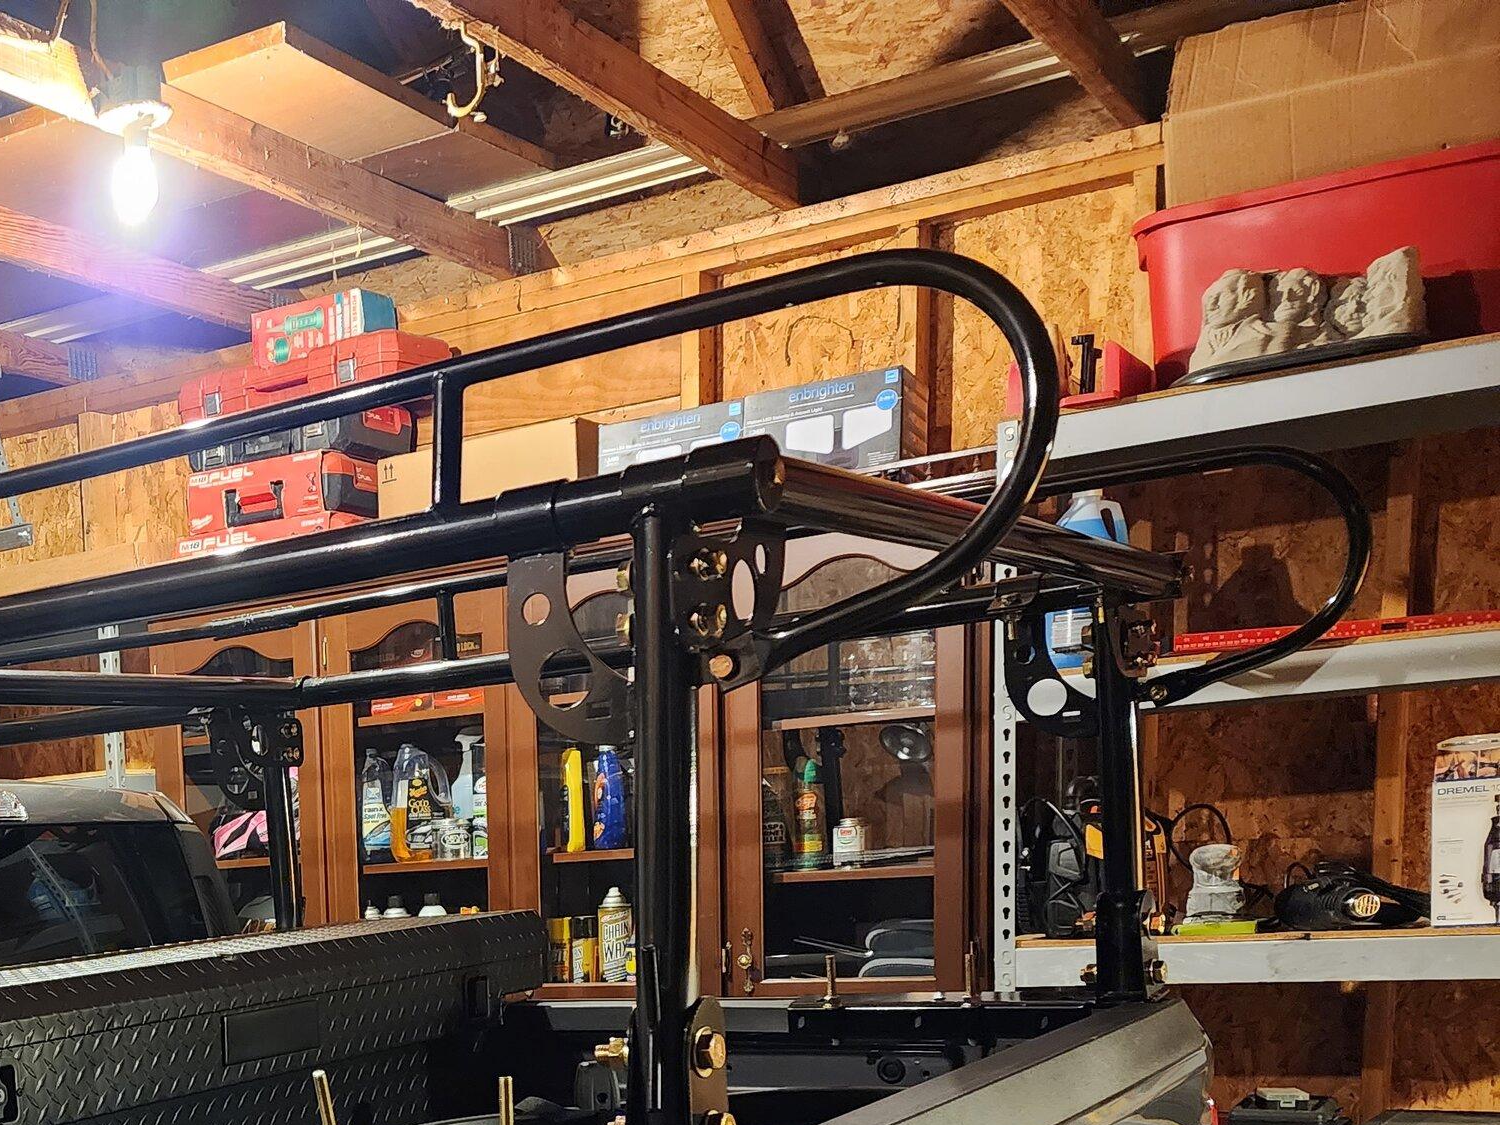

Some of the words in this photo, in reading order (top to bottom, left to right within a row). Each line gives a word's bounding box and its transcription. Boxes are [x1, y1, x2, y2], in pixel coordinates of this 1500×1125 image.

[788, 381, 855, 403] enbrighten
[640, 413, 700, 432] enbrighten
[209, 466, 254, 482] FUEL
[180, 541, 200, 551] M18
[203, 531, 257, 549] FUEL
[1437, 785, 1490, 796] DREMEL
[603, 921, 629, 940] CHAIN
